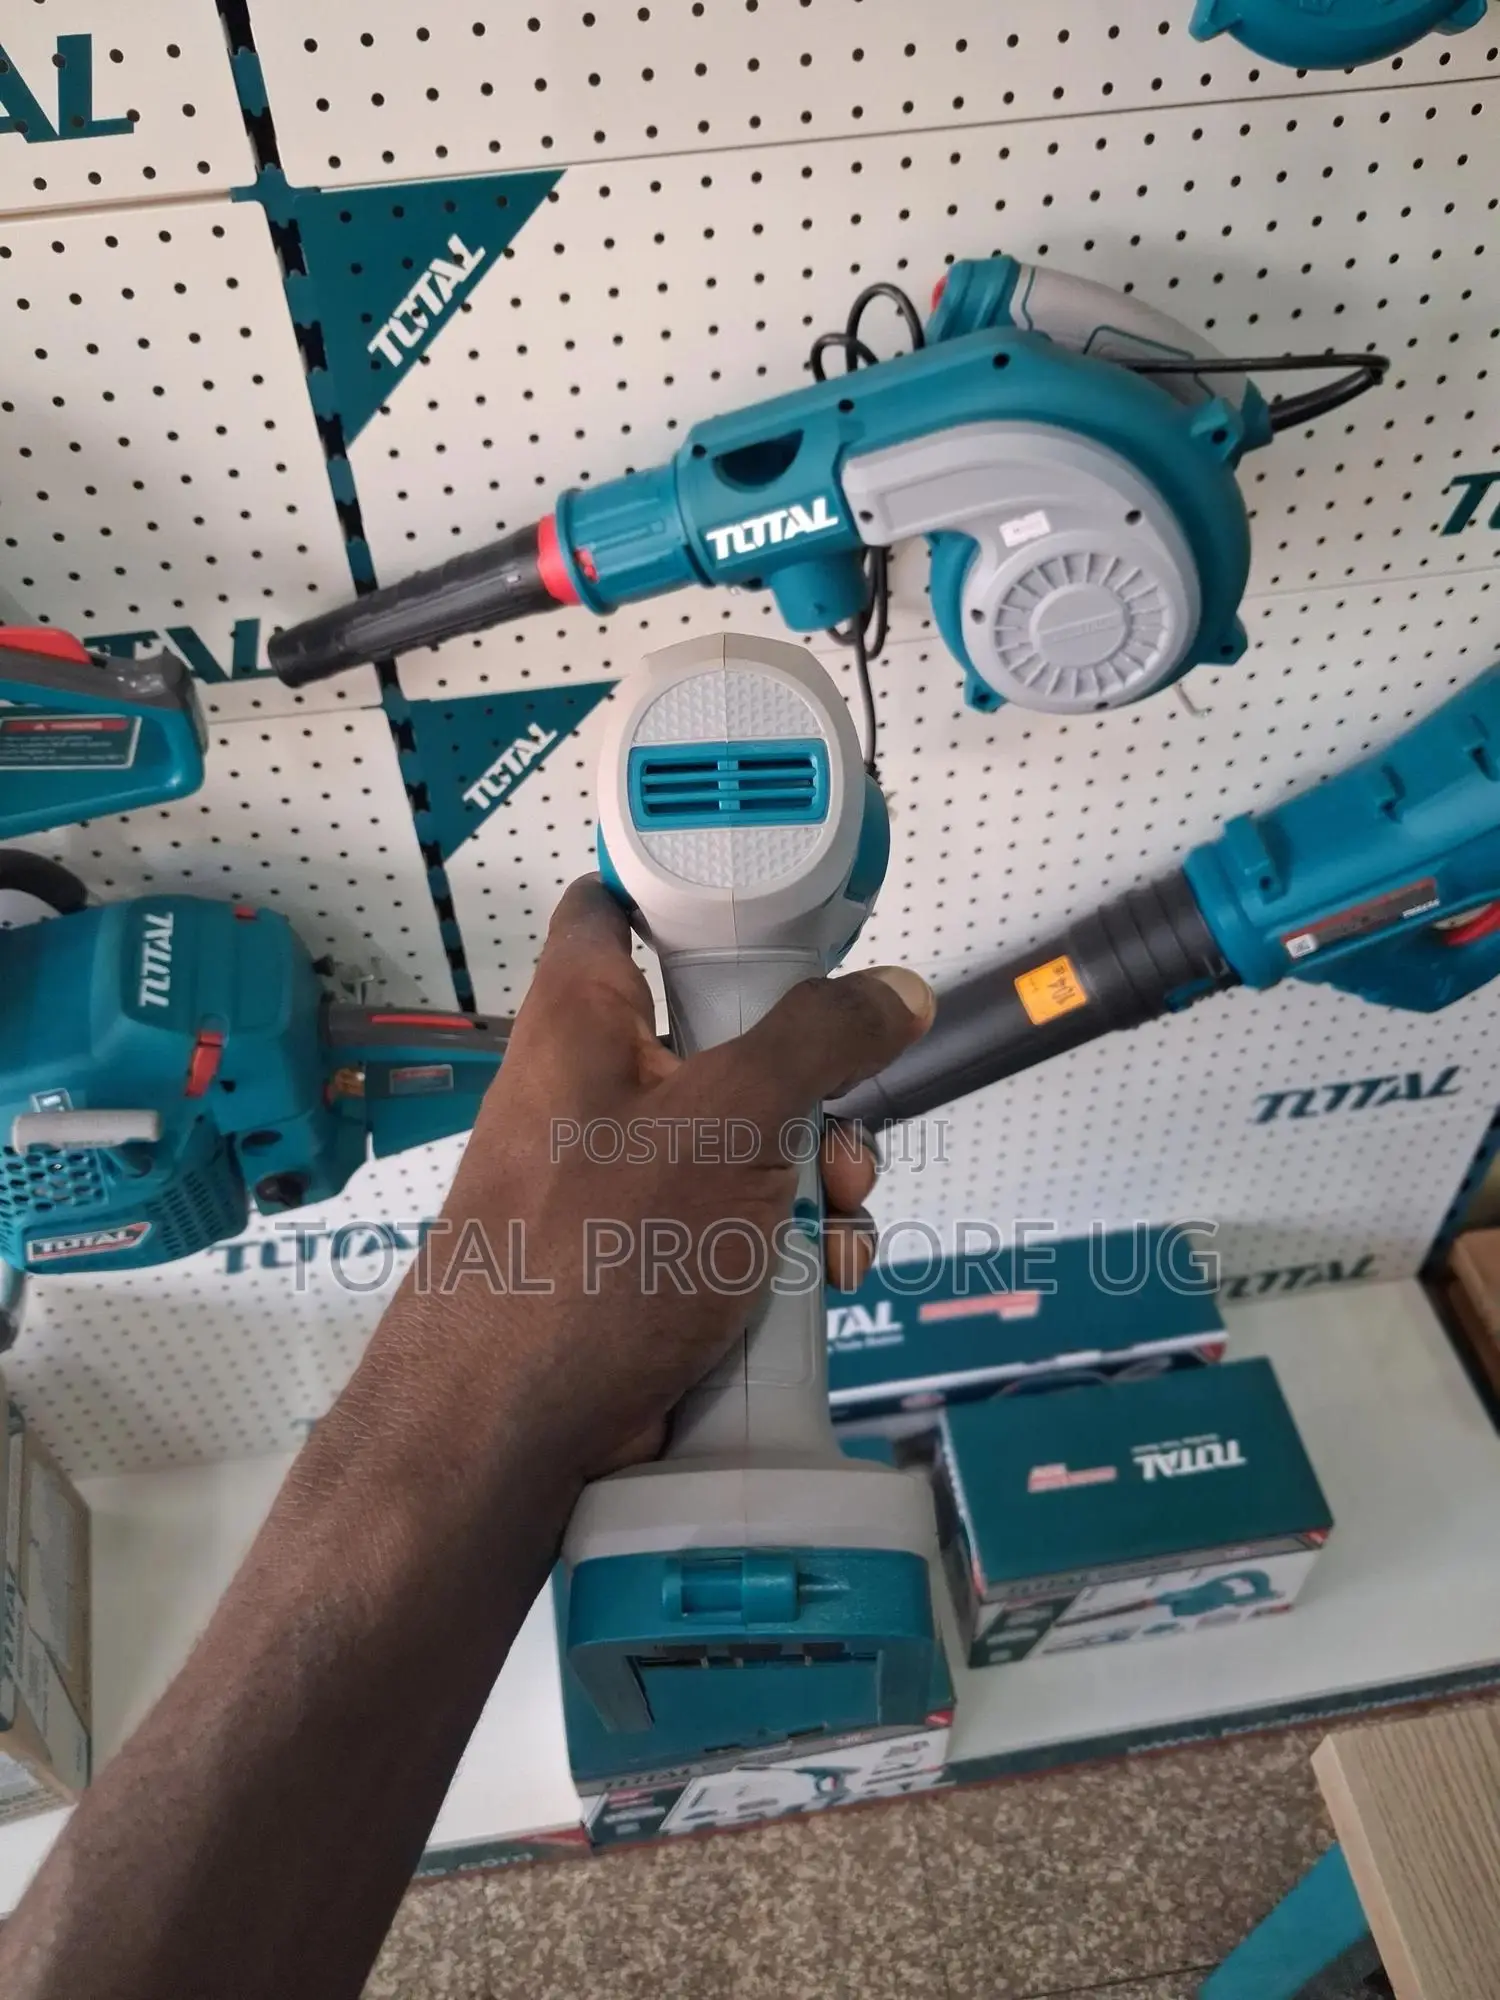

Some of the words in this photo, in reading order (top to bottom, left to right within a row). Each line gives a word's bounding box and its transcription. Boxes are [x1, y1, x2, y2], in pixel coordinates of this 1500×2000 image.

[366, 232, 486, 368] TOTAL
[705, 496, 840, 560] TOTAL
[462, 721, 558, 810] TOTAL
[138, 910, 175, 1008] TOTAL
[1252, 1064, 1464, 1125] TOTAL
[34, 1229, 134, 1253] TOTAL
[1132, 1439, 1247, 1482] TOTAL
